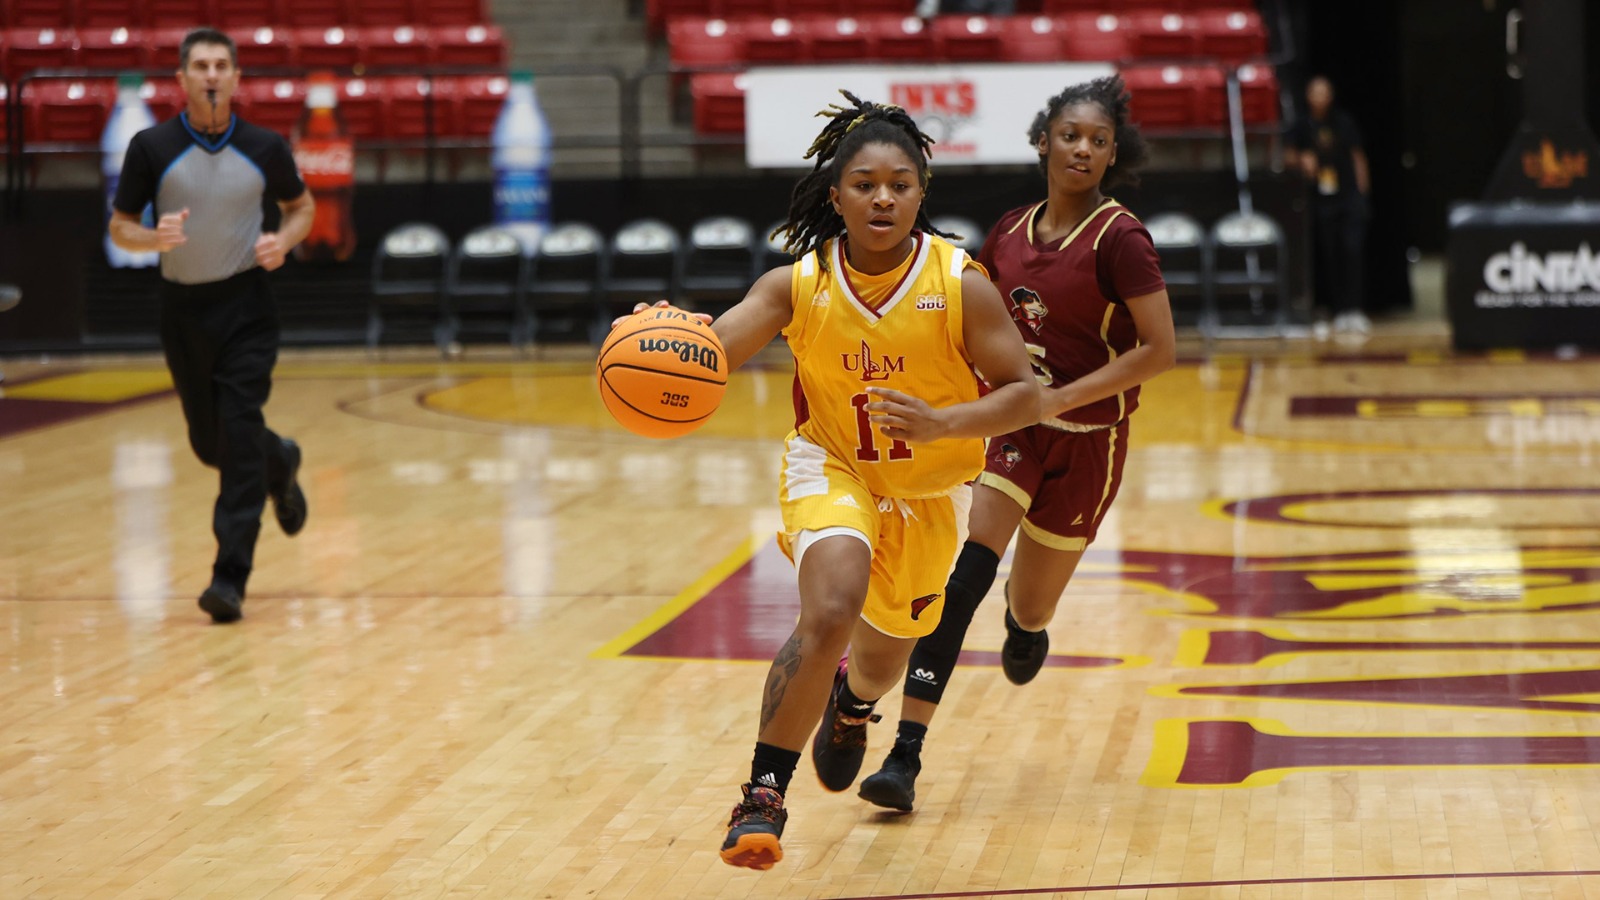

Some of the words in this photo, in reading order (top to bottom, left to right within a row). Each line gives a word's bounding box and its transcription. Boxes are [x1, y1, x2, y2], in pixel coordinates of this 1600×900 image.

[915, 294, 947, 311] SBC
[638, 338, 719, 373] Wilson
[840, 338, 905, 382] ULM
[660, 391, 690, 408] SBC
